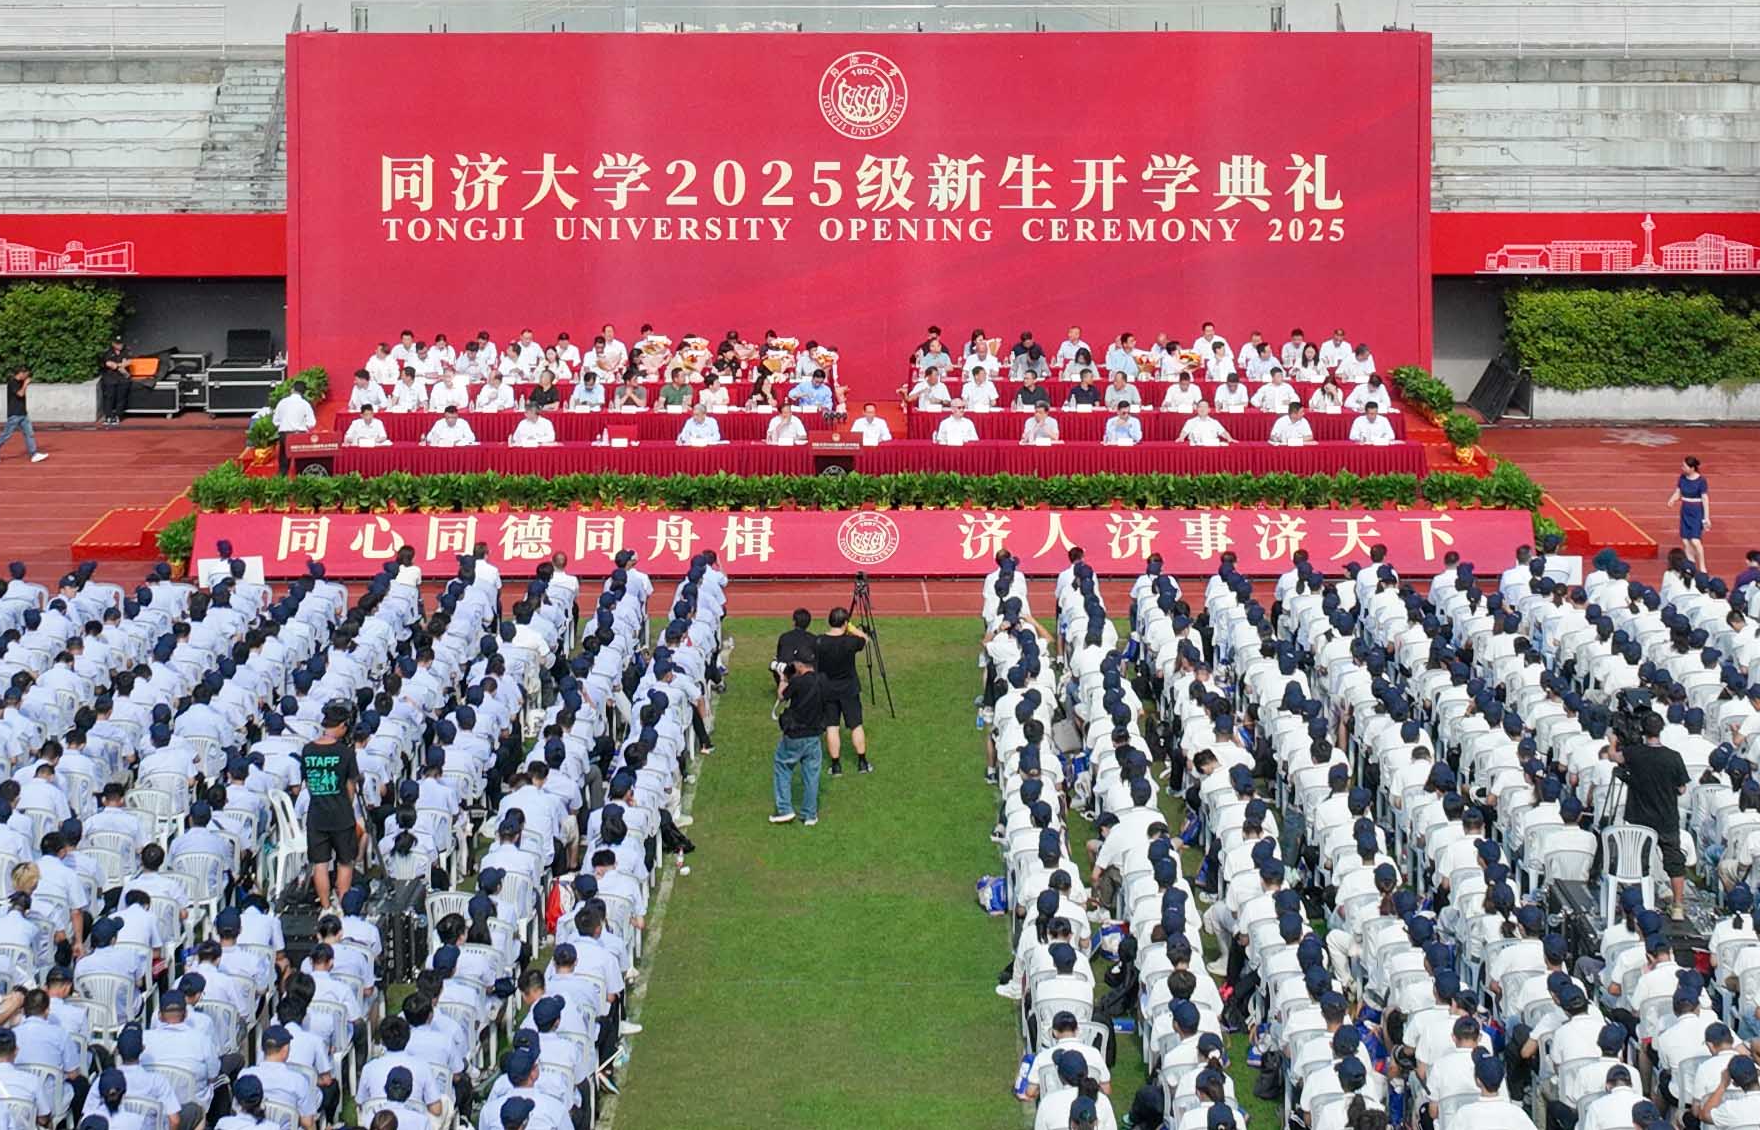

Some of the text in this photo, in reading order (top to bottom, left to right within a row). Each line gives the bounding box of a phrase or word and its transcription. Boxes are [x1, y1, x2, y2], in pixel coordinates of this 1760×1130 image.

[822, 93, 905, 136] TONGJI UNIVERSITY
[382, 153, 1344, 213] 同济大学2025级新生开学典礼
[382, 217, 1345, 242] TONGJI UNIVERSITY OPENING CEREMONY 2025
[277, 514, 775, 562] 同心同德同舟楫
[958, 512, 1454, 561] 济人济事济天下
[304, 756, 340, 767] STAFF
